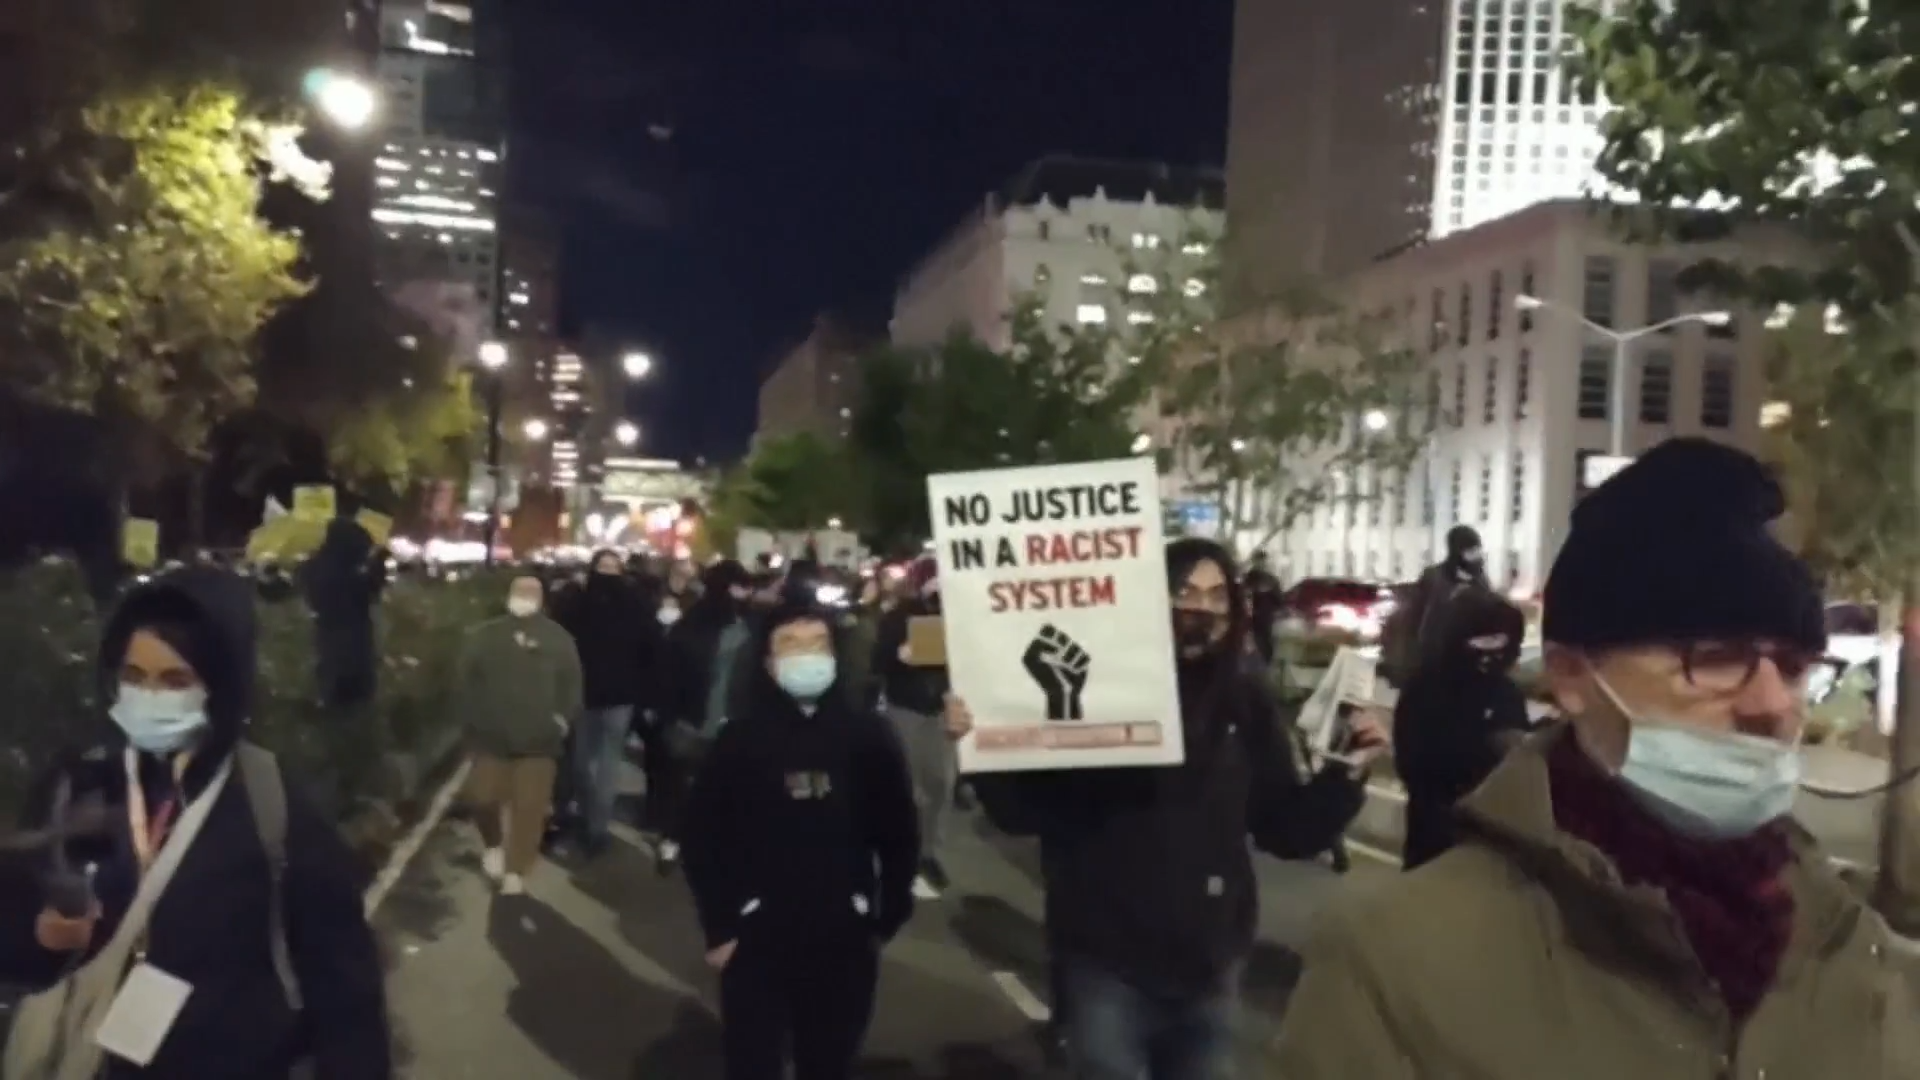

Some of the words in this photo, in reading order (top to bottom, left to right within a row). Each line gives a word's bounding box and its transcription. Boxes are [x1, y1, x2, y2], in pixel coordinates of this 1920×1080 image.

[944, 491, 990, 526] NO
[1001, 482, 1141, 523] JUSTICE
[951, 537, 984, 570] IN
[995, 536, 1016, 567] A
[1025, 526, 1142, 566] RACIST
[988, 575, 1116, 613] SYSTEM
